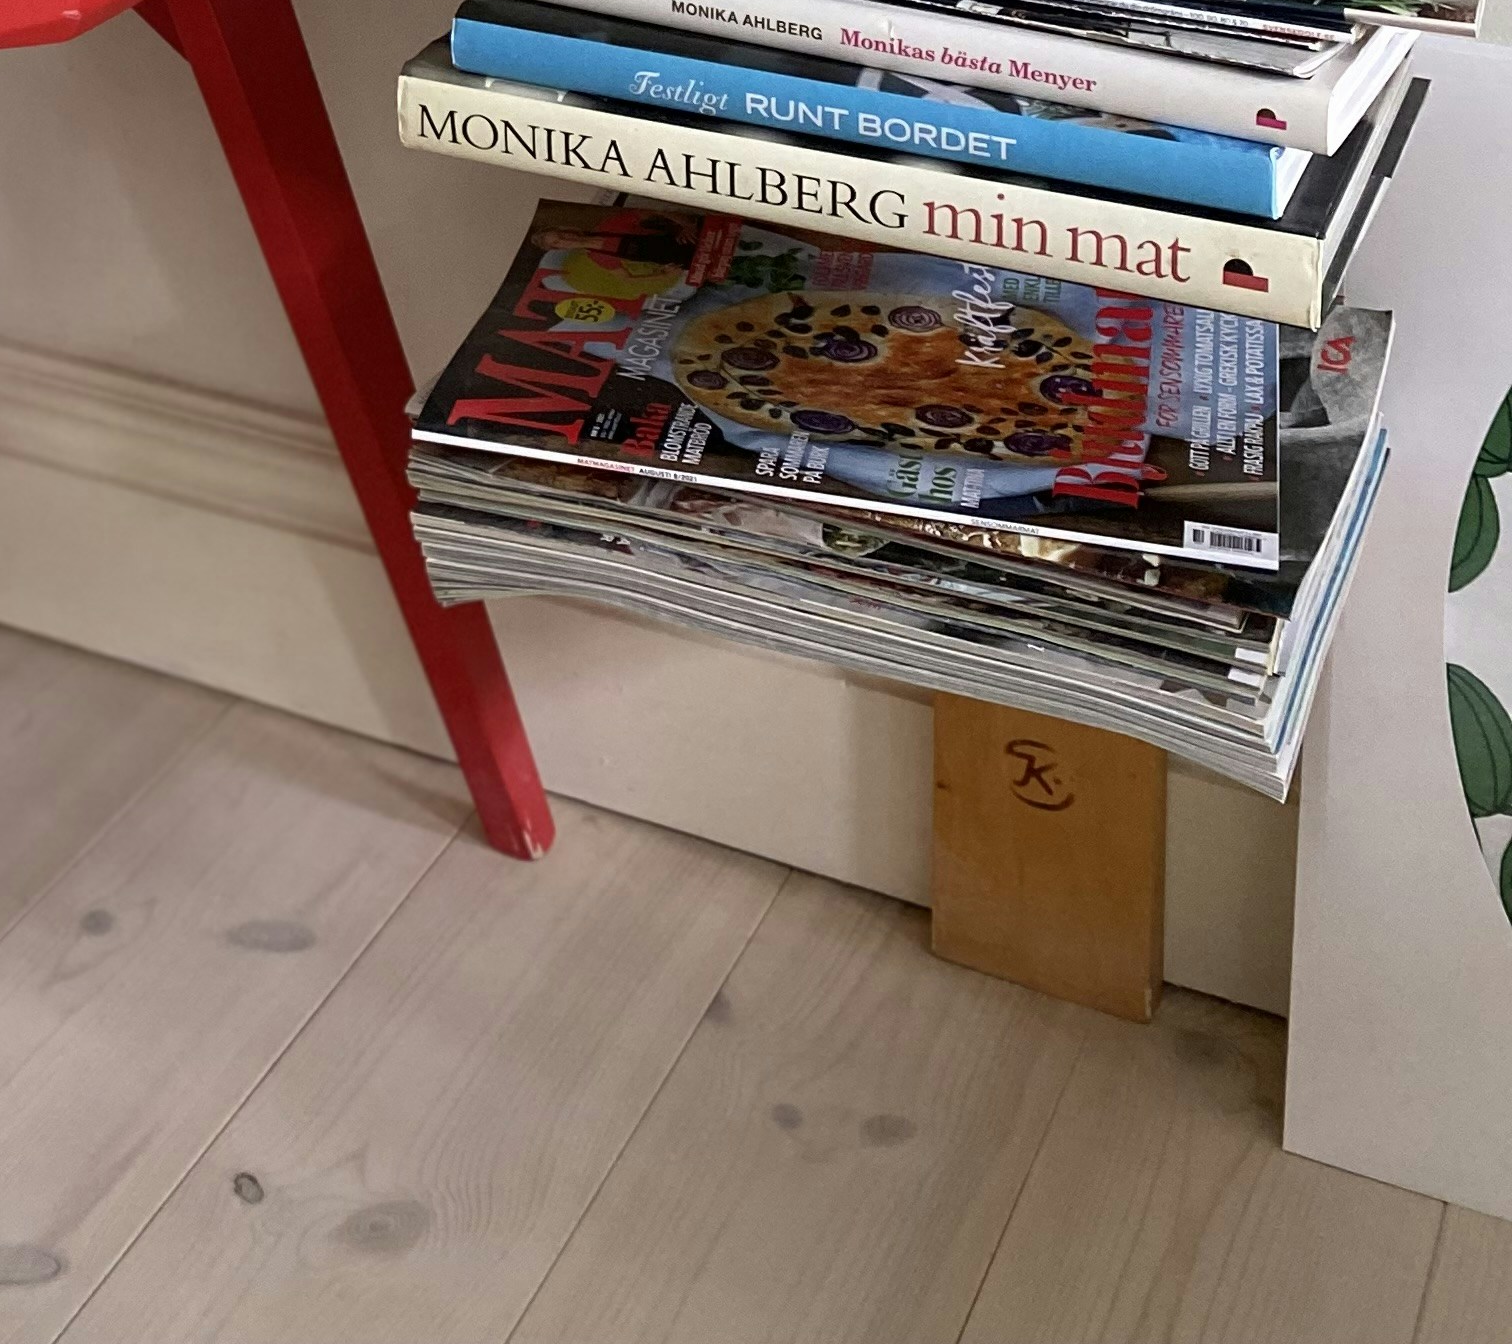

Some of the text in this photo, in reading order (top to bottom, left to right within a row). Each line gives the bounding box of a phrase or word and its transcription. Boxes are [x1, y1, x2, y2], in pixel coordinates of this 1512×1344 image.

[671, 0, 1097, 92] MONIKA AHLBERG Monikas bästa Menyer
[628, 71, 1017, 160] Festligt RUNT BORDET
[417, 105, 1191, 283] MONIKA AHLBERG min mat
[445, 267, 647, 446] MAT
[616, 295, 683, 381] MAGASINET
[1218, 346, 1238, 386] GREKISK
[1317, 336, 1357, 374] ICA
[1244, 383, 1264, 404] LAX
[756, 446, 779, 477] SPARA
[918, 467, 958, 503] hos
